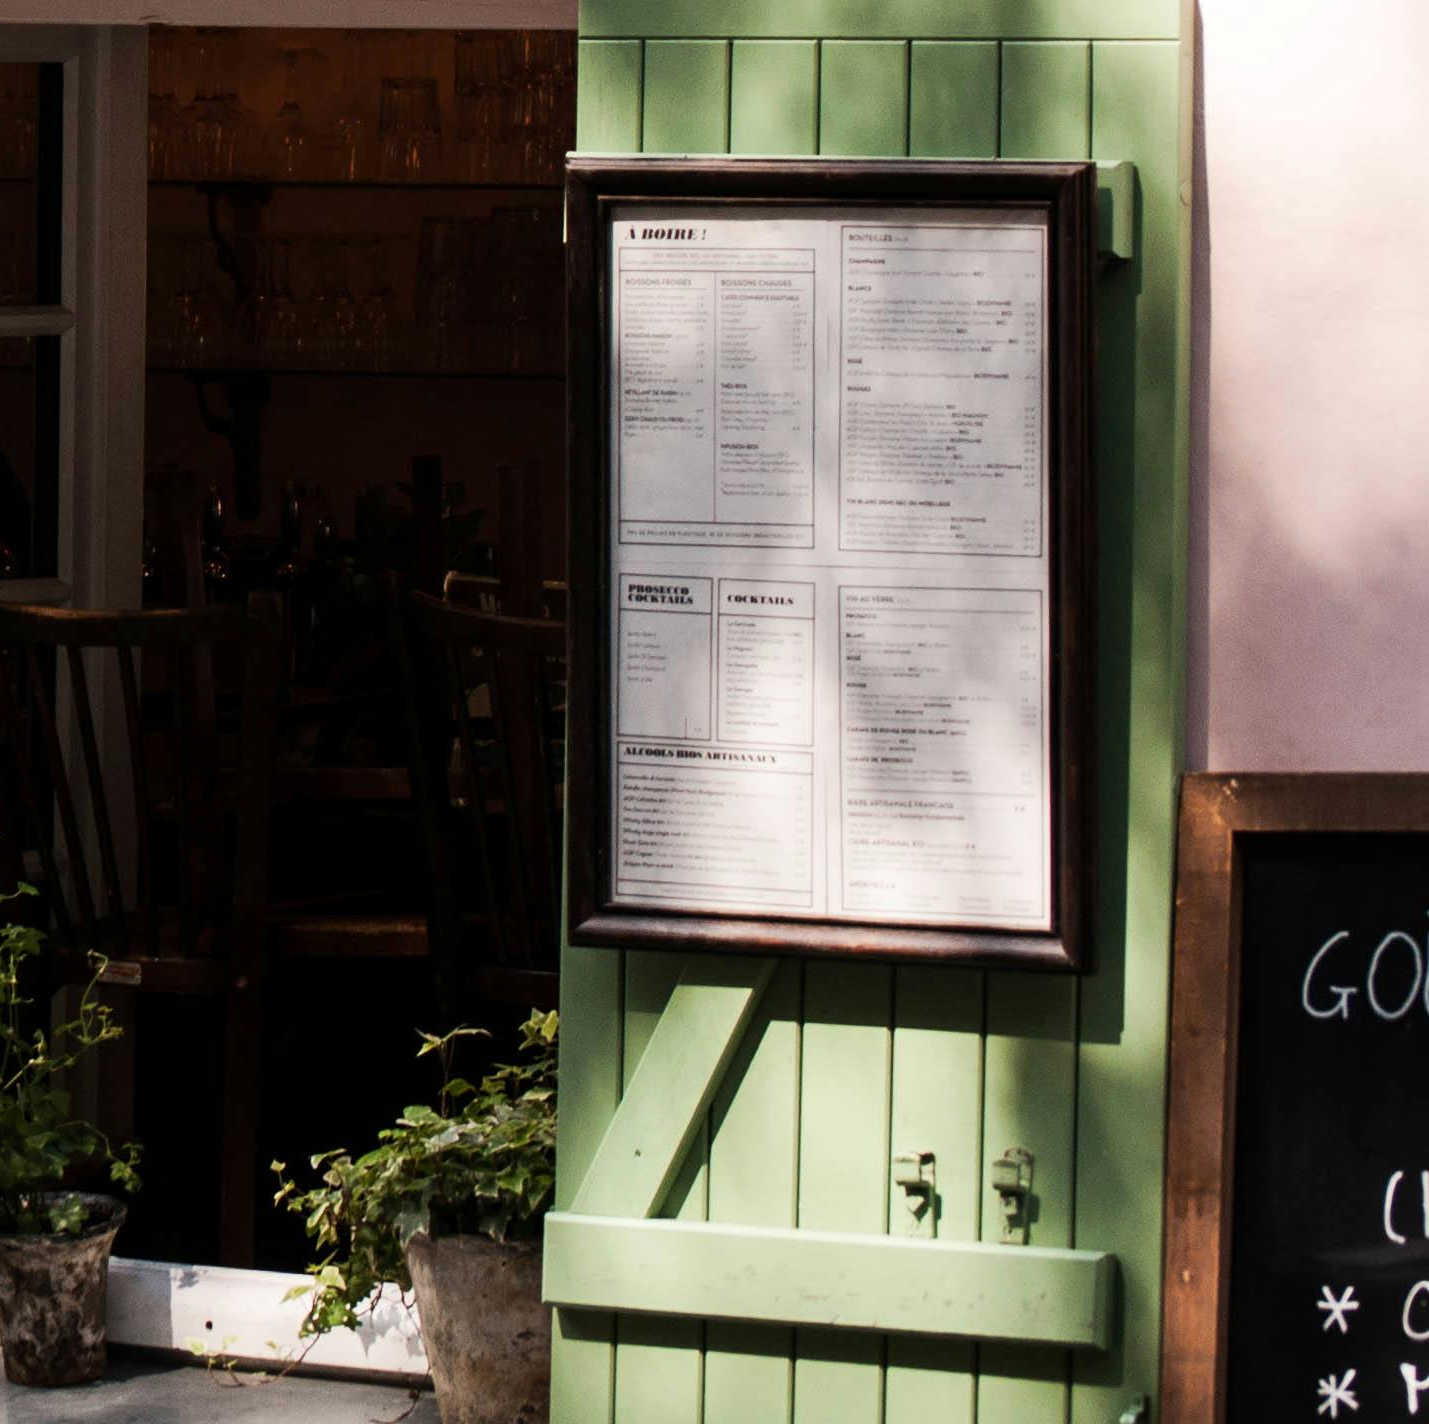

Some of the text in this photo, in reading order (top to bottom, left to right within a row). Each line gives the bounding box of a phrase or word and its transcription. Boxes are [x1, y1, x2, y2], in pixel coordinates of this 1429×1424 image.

[641, 228, 699, 240] BOIRE
[628, 584, 689, 595] PROSECCO
[628, 594, 693, 605] COCKTAILS
[727, 595, 794, 605] COCKTAILS
[624, 747, 674, 758] ALCOOLS
[1302, 930, 1429, 1020] GO
